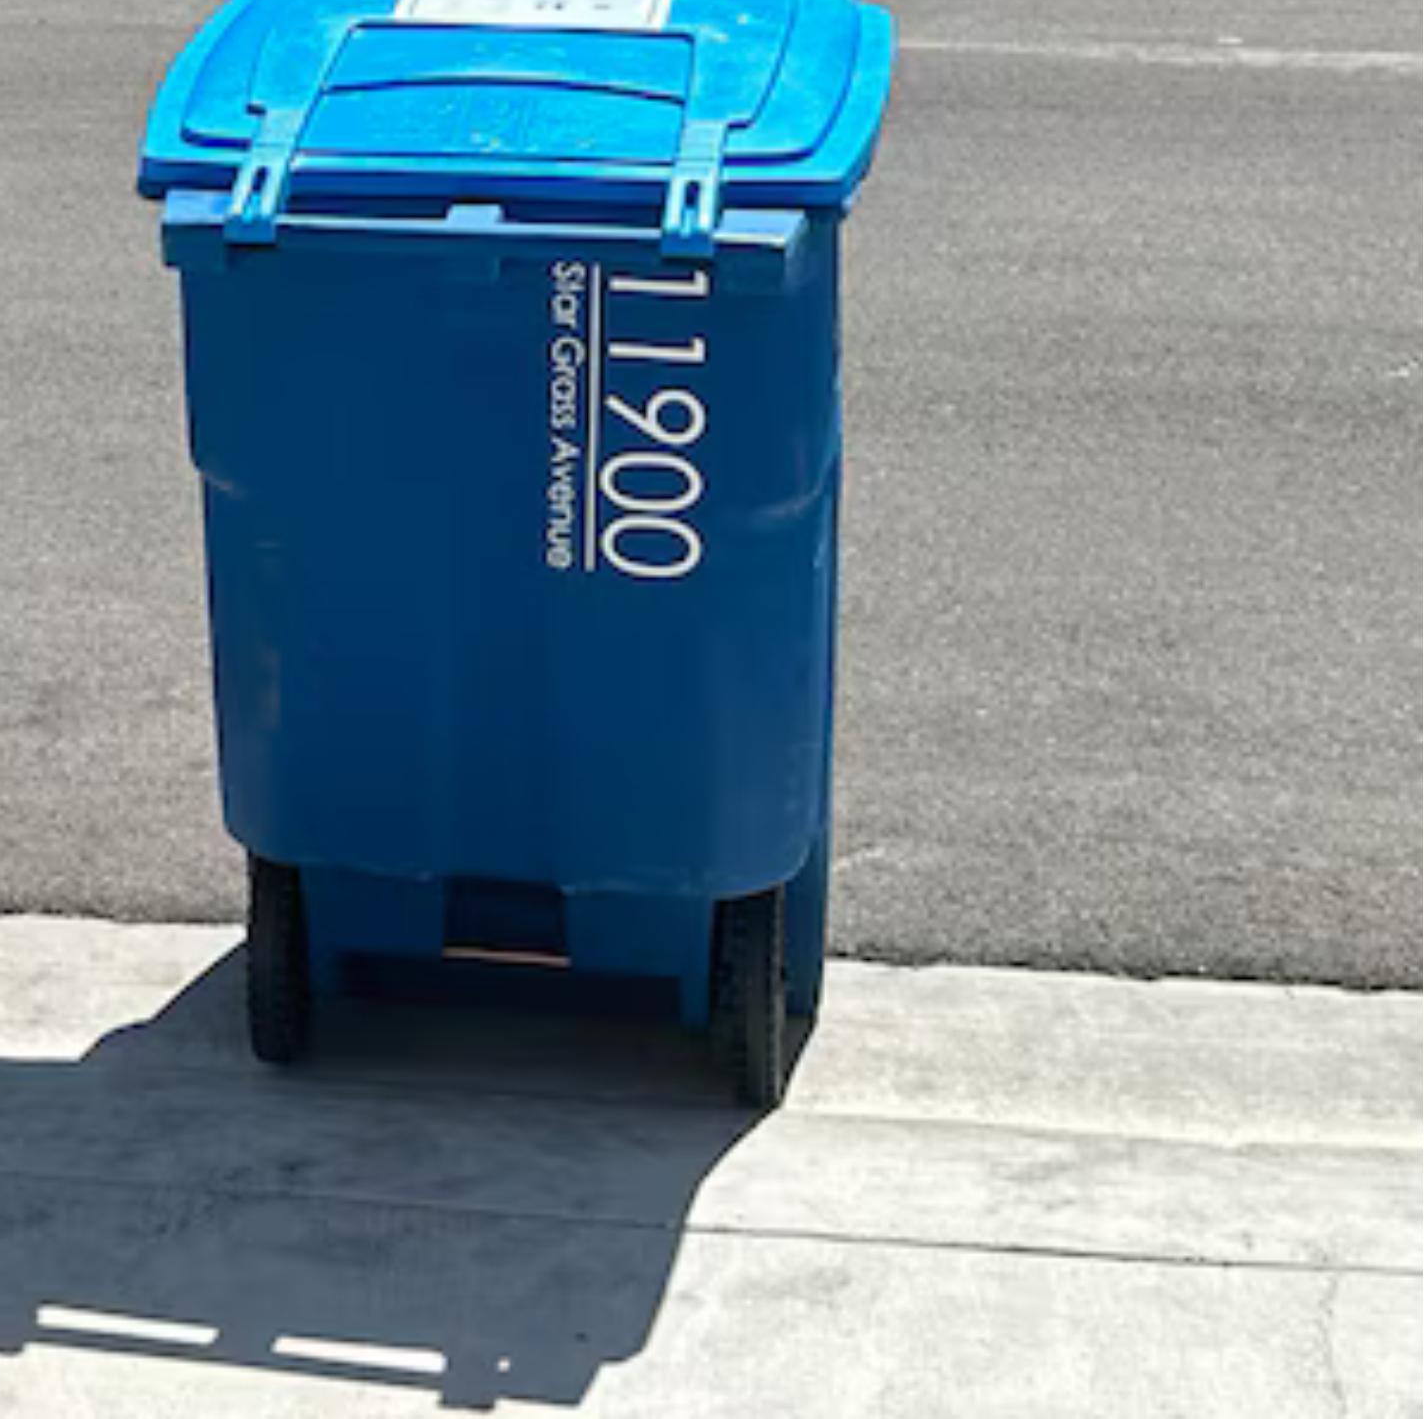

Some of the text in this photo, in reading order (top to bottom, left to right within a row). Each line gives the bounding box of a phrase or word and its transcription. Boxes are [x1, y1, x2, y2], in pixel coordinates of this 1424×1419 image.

[544, 260, 586, 570] Star Grass Avenue
[599, 269, 710, 578] 11900
